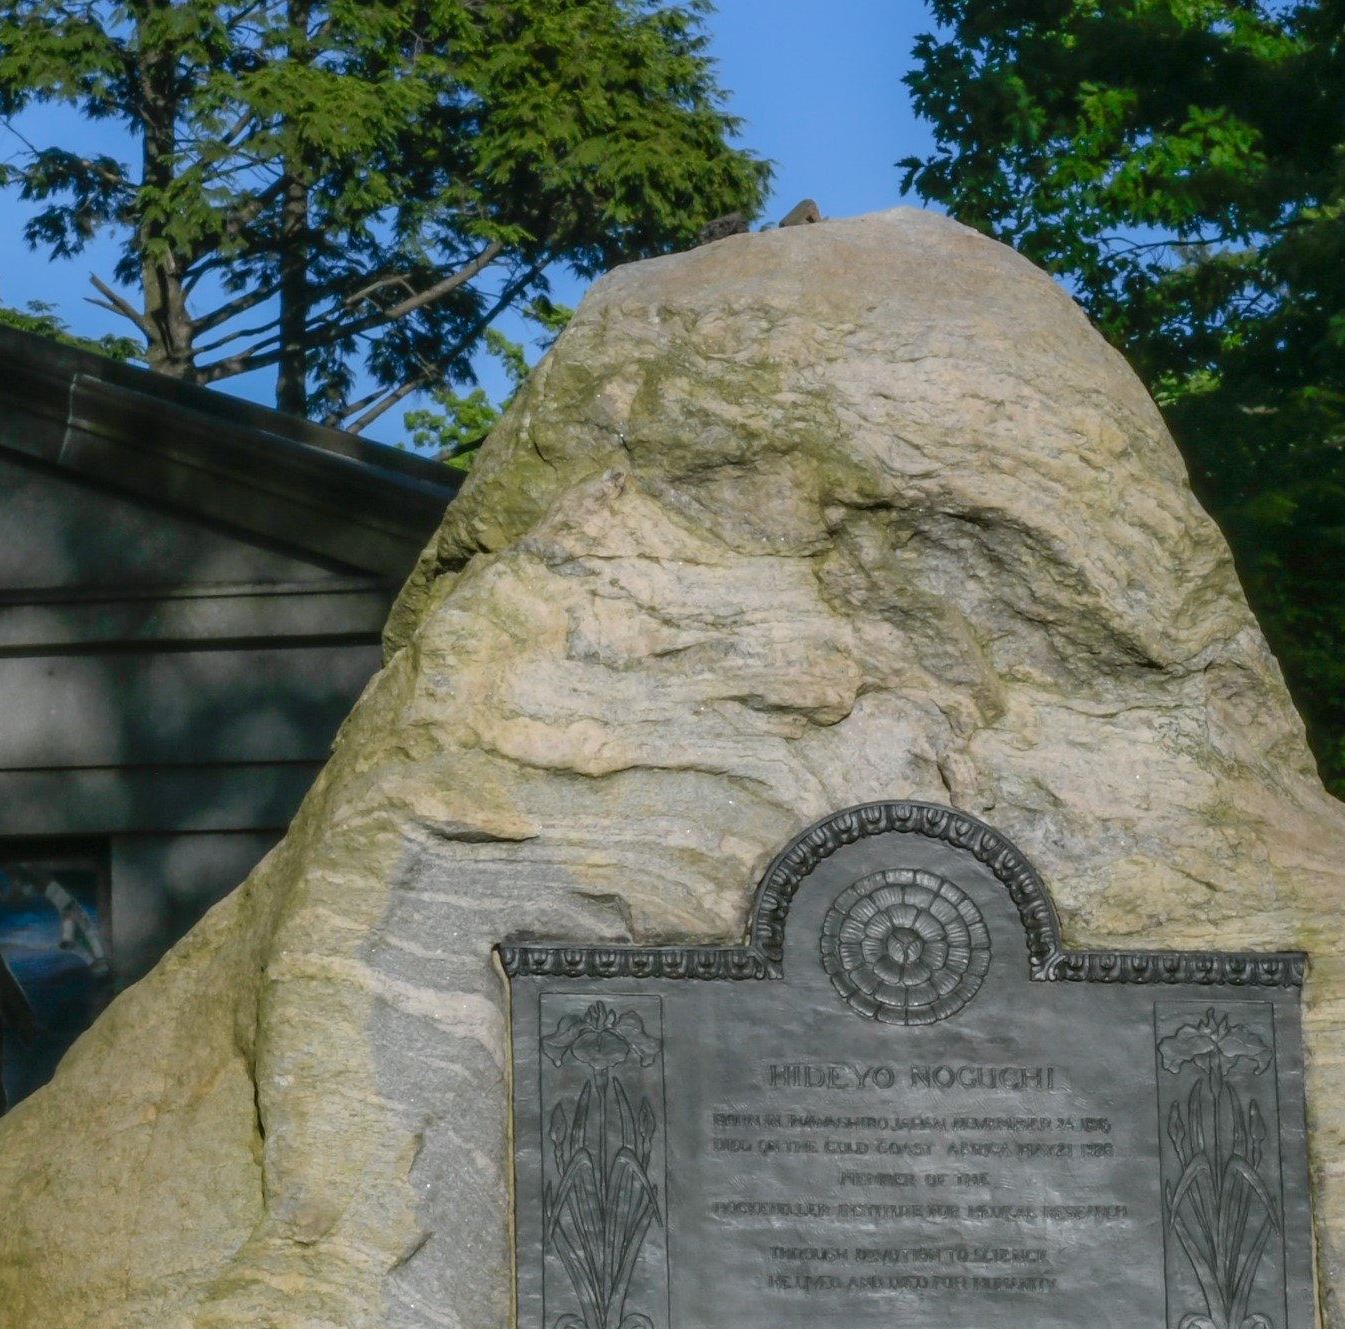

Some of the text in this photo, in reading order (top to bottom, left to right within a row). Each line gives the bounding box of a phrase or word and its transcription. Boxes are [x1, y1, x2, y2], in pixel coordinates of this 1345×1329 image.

[769, 1064, 1054, 1090] HIDEYO NOGUCHI
[712, 1113, 760, 1127] BORN
[953, 1117, 1052, 1132] NOVEMBER
[712, 1138, 752, 1153] DIED
[783, 1141, 818, 1153] THE
[824, 1140, 869, 1155] GOLD
[875, 1139, 935, 1156] COAST
[839, 1172, 990, 1187] MEMBER OF THE
[712, 1202, 1128, 1220] ROCKEFELLER INSTITUTE FOR MEDICAL RESEARCH
[771, 1247, 1048, 1264] THROUGH DEVOTION TO SCIENCE
[769, 1275, 792, 1290] HE
[848, 1276, 886, 1290] AND
[932, 1276, 967, 1291] FOR
[971, 1276, 1058, 1292] HUMANITY
